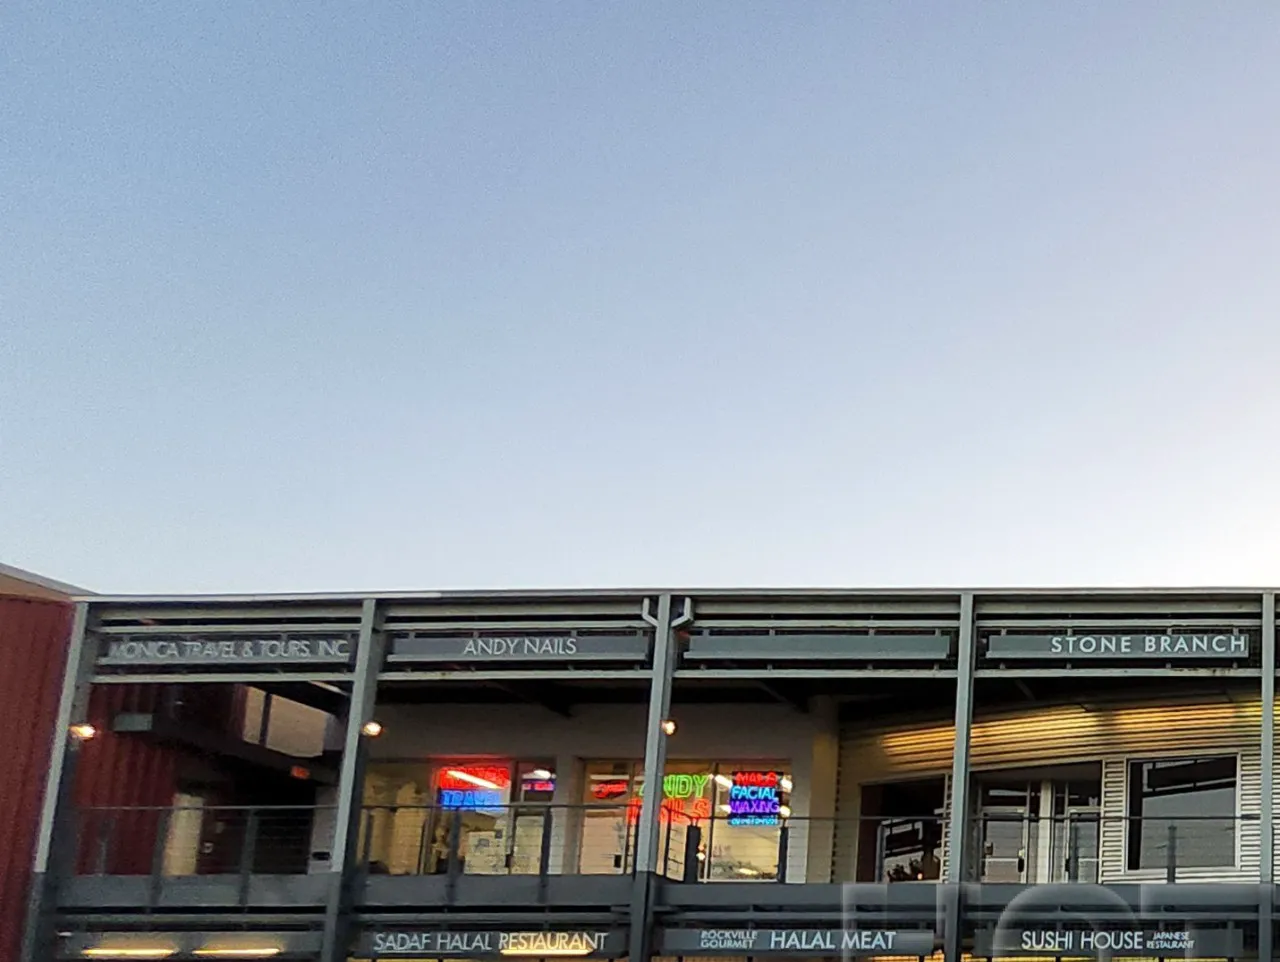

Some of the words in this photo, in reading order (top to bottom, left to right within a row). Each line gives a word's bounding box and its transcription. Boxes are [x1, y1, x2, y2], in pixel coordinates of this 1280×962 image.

[182, 640, 237, 659] TRAVEL
[240, 640, 254, 657] &
[463, 637, 519, 655] ANDY
[523, 637, 577, 655] NAILS
[1050, 636, 1133, 653] STONE
[1144, 635, 1246, 652] BRANCH
[731, 785, 780, 801] FACIAL
[373, 932, 431, 950] SADAF
[436, 932, 493, 950] HALAL
[498, 932, 609, 950] RESTAURANT
[700, 930, 757, 940] ROCKVILLE
[700, 939, 754, 949] GOURMET
[770, 930, 836, 950] HALAL
[841, 930, 897, 950] MEAT
[1021, 930, 1073, 950] SUSHI
[1080, 931, 1144, 950] HOUSE
[1152, 931, 1190, 940] JAPANESE
[1146, 940, 1195, 949] RESTAURANT
